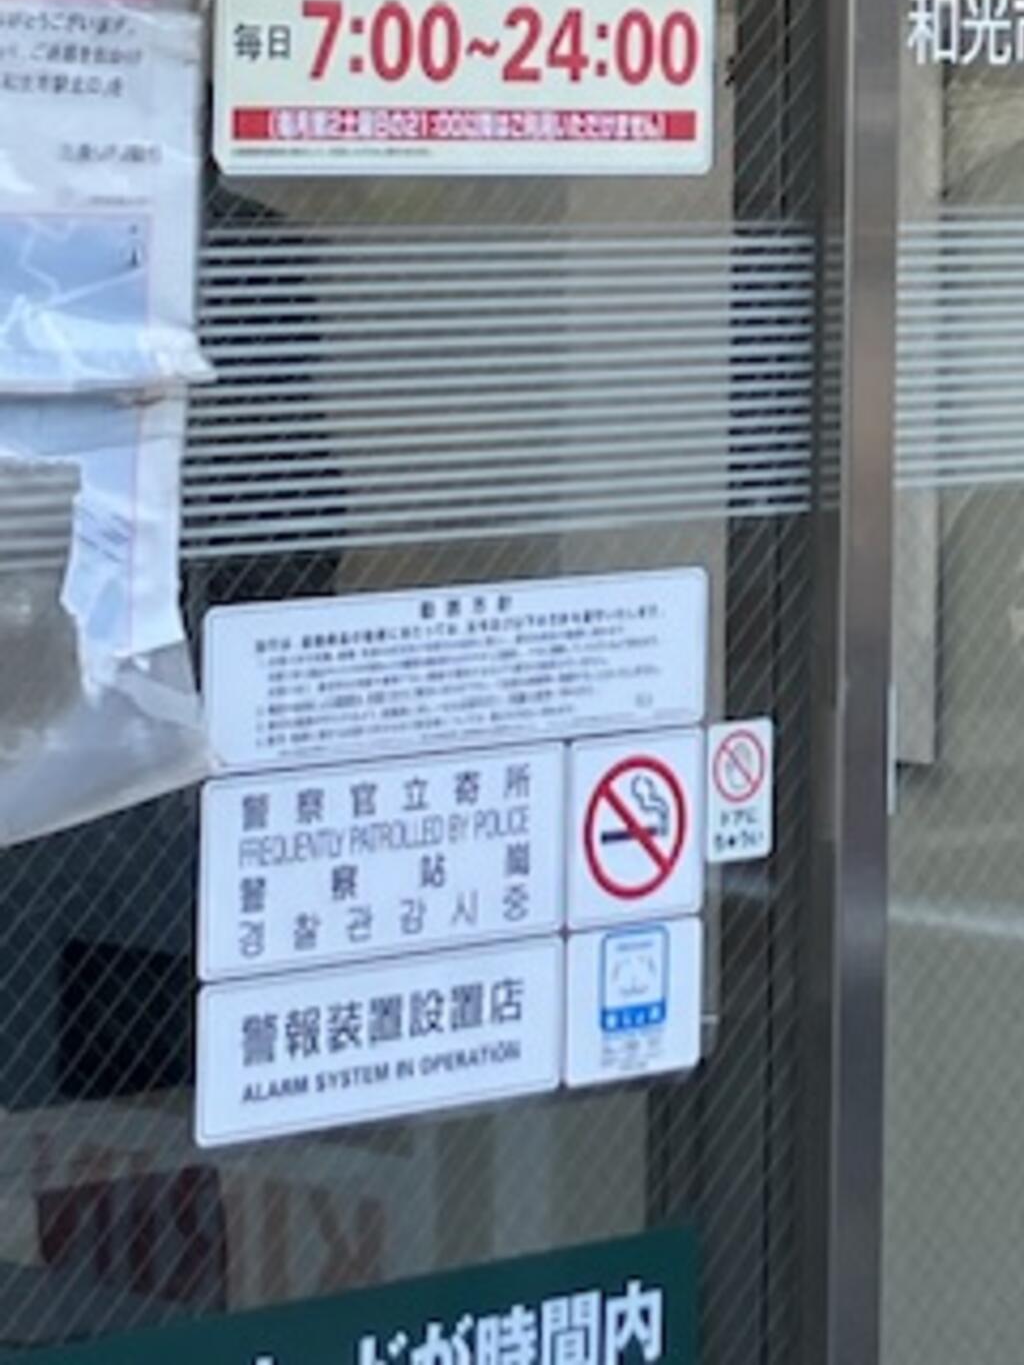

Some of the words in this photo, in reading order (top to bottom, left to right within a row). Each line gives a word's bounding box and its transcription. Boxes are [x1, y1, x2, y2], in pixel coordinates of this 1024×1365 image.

[234, 24, 291, 61] 毎日
[239, 829, 343, 867] FREQUENTLY
[350, 815, 444, 854] PATROLLED
[474, 804, 529, 841] POLICE
[242, 979, 524, 1066] 警報装置設置店
[243, 1075, 309, 1103] ALARM
[315, 1060, 389, 1093] SYSTEM
[396, 1058, 415, 1080] IN
[419, 1041, 521, 1077] OPERATION
